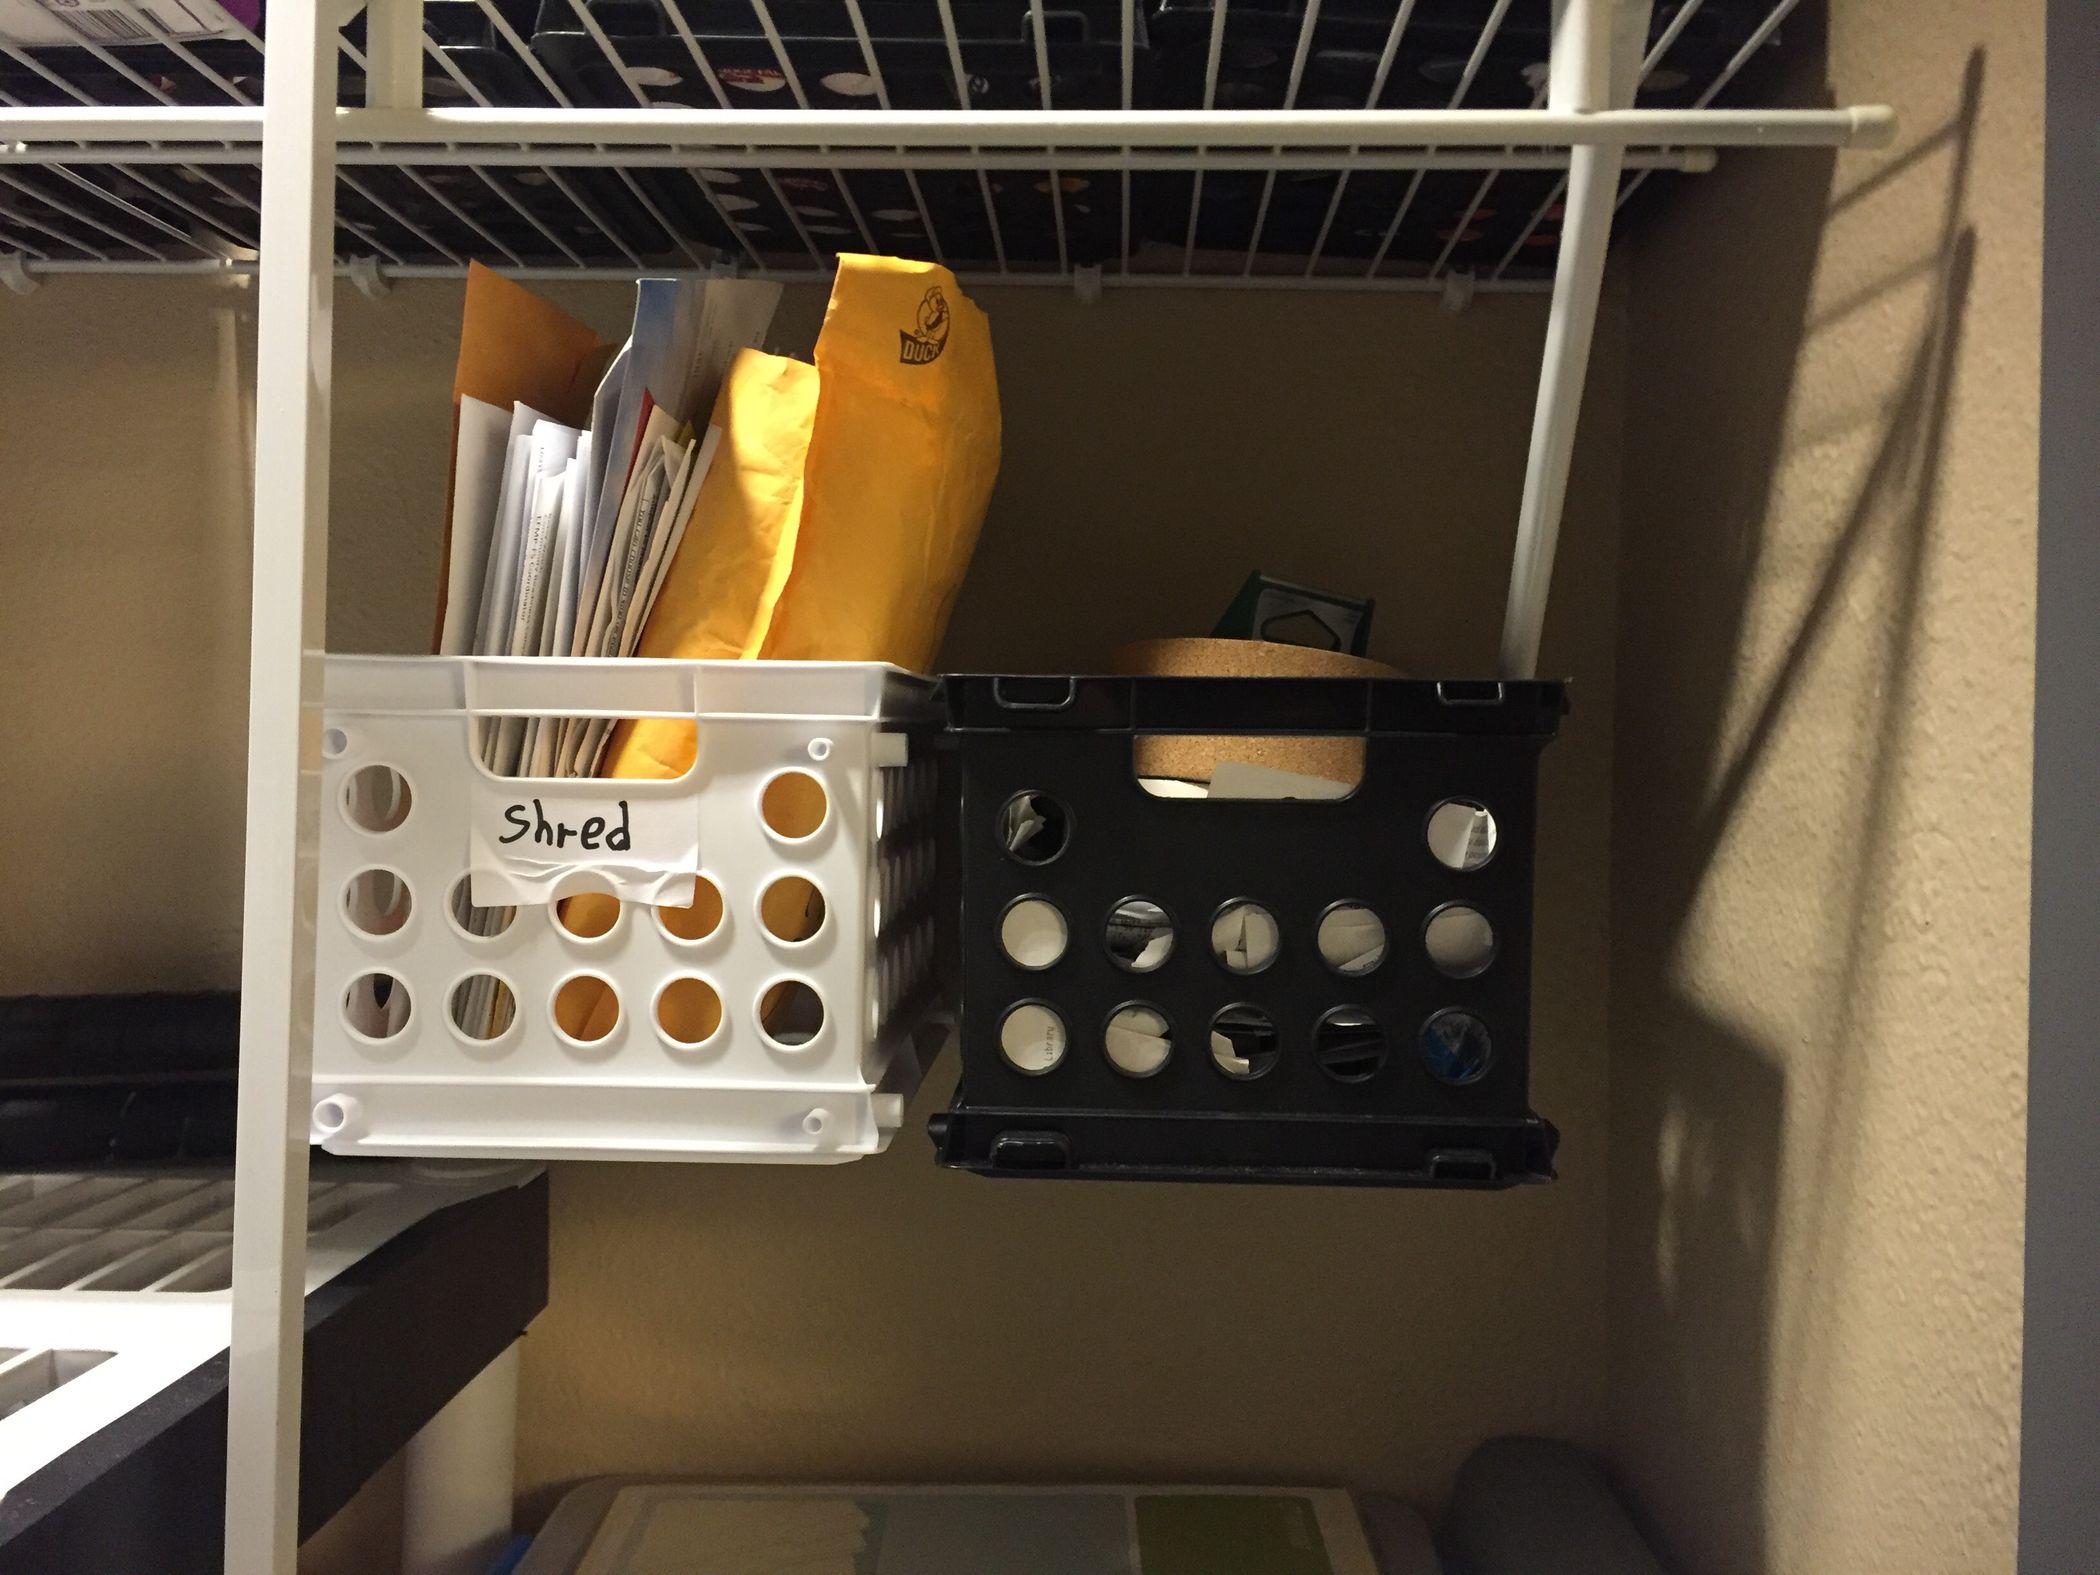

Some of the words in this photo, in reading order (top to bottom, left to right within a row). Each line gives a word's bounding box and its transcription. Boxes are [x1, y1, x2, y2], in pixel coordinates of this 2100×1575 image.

[903, 340, 939, 362] DUCK
[637, 508, 646, 526] You
[499, 799, 631, 850] Shred
